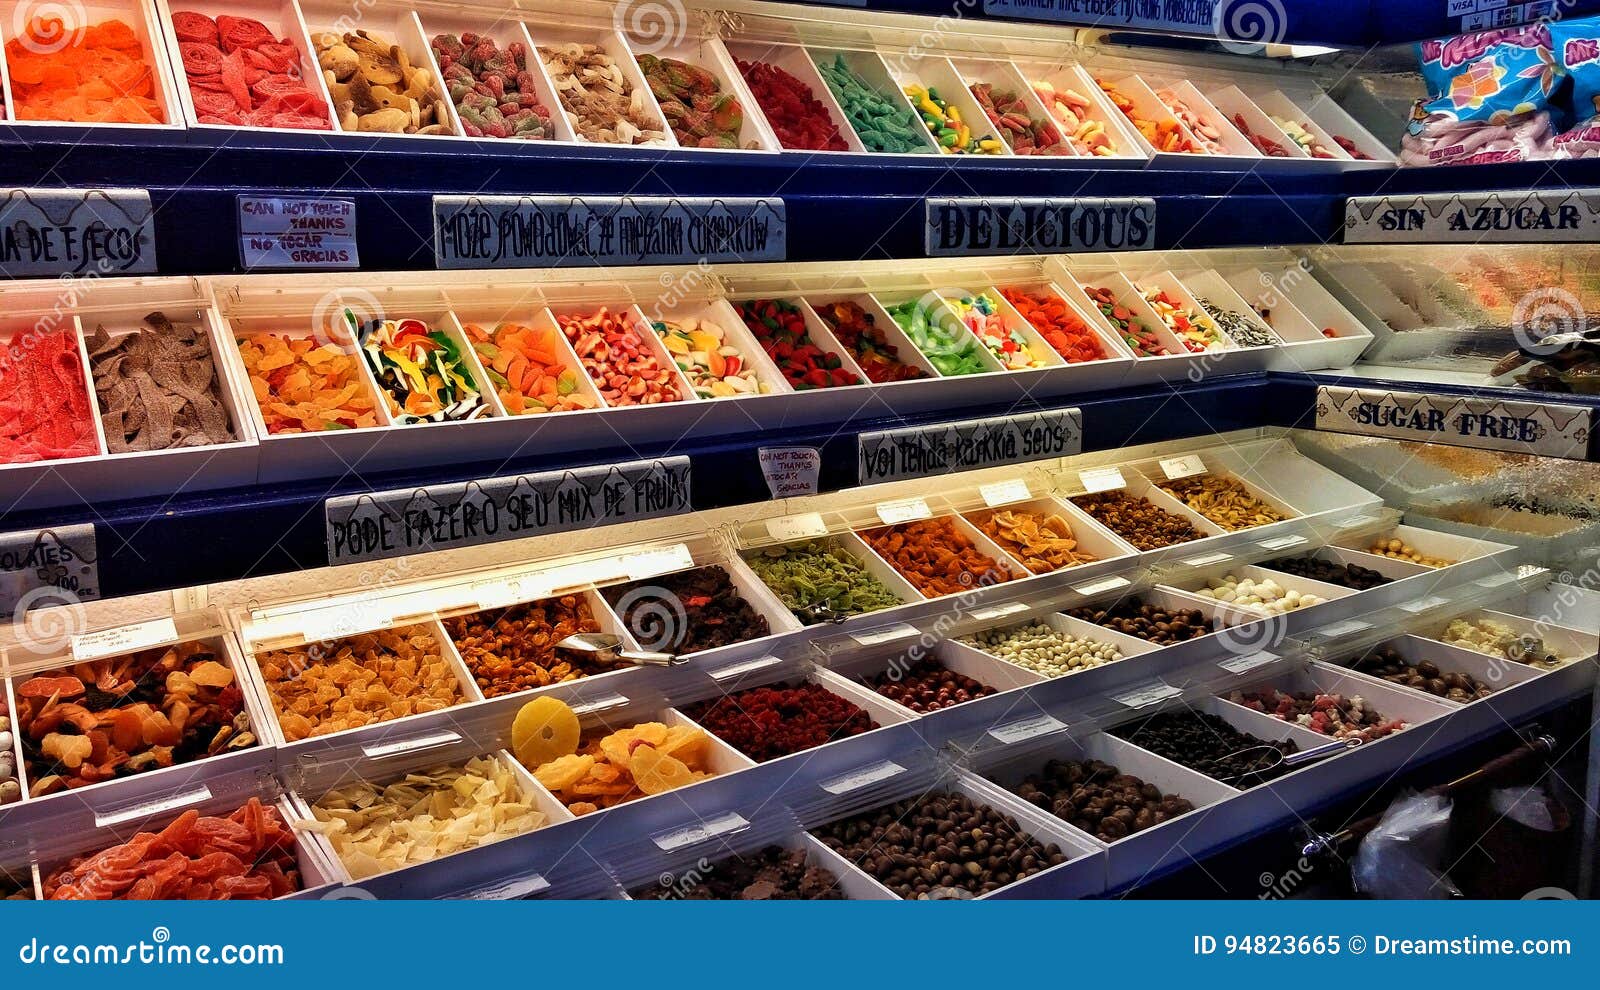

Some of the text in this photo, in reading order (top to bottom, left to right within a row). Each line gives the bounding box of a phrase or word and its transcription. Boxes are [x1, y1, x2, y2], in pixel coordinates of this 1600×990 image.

[1452, 2, 1474, 11] VISA
[242, 202, 350, 215] CAN NOT TOUCH
[1381, 204, 1580, 232] SIN AZUCAR
[290, 217, 346, 230] THANKS
[938, 205, 1149, 250] DELICIOUS
[29, 227, 58, 262] DE
[73, 226, 144, 273] SECOS
[250, 235, 322, 250] NO TOCAR
[291, 250, 350, 263] GRACIAS
[1357, 402, 1539, 443] SUGAR FREE
[334, 512, 395, 558] PODE
[404, 501, 478, 548] FAZER
[507, 494, 549, 533] SEU
[557, 487, 597, 525] MIX
[602, 481, 626, 517] DE
[634, 466, 689, 513] FRUTAS
[0, 542, 74, 572] OLATES
